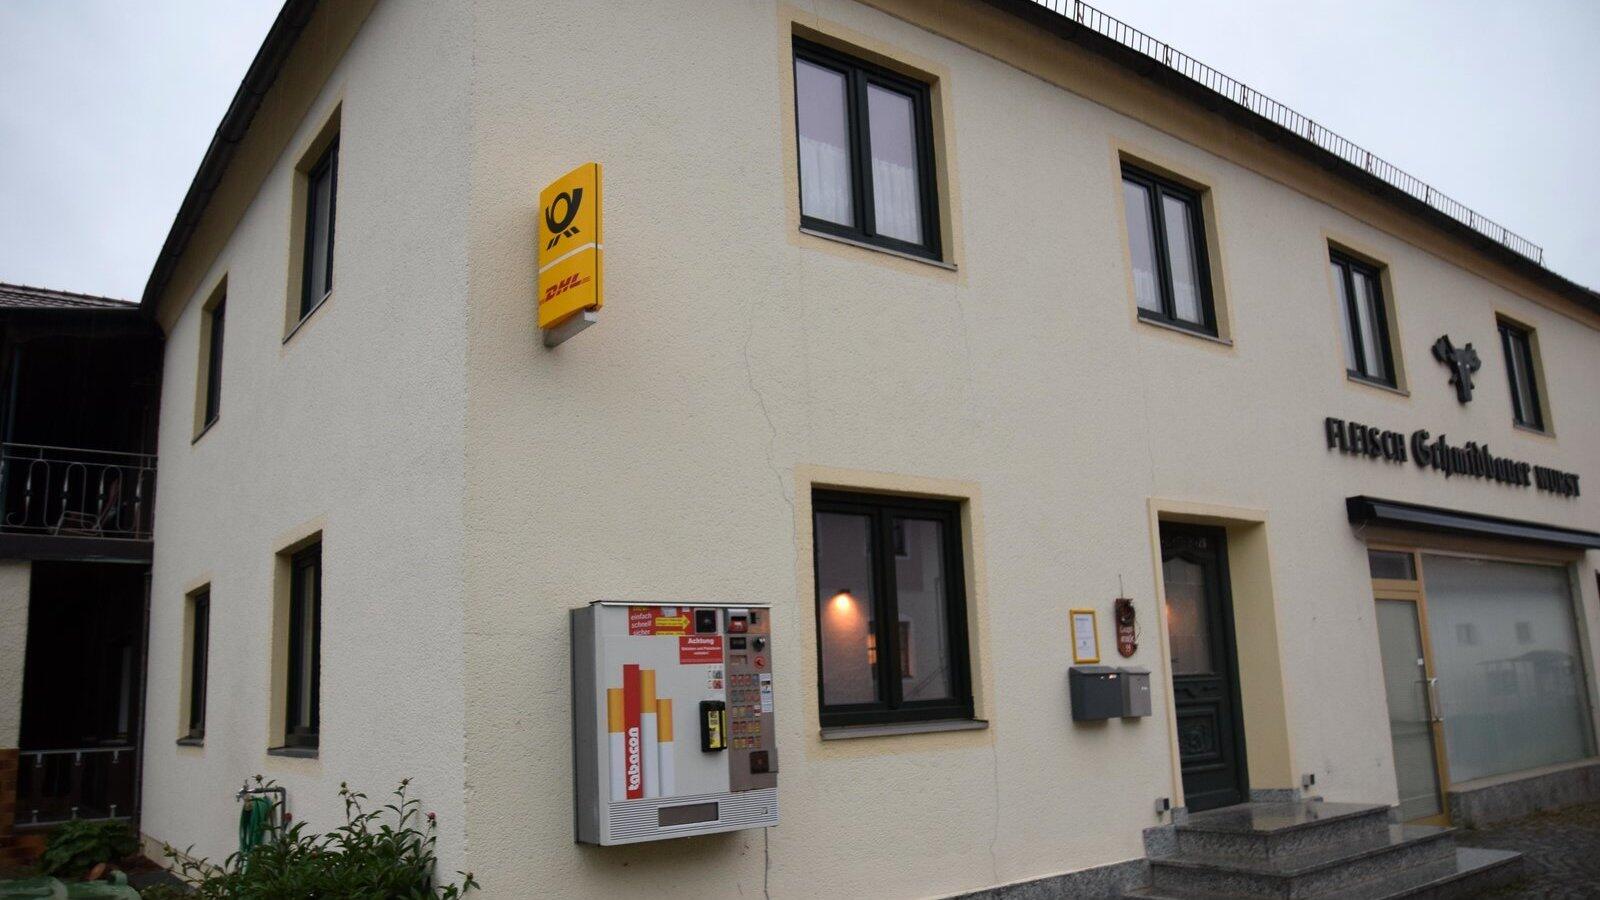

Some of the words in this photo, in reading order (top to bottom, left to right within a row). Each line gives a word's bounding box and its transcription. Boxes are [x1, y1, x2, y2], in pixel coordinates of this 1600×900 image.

[545, 272, 582, 302] DHL
[1325, 416, 1408, 463] FLEISCH
[1533, 465, 1580, 498] WURST
[630, 613, 652, 621] einfach
[631, 620, 652, 629] schnell
[687, 637, 715, 646] Achtung
[627, 726, 640, 791] tabacon
